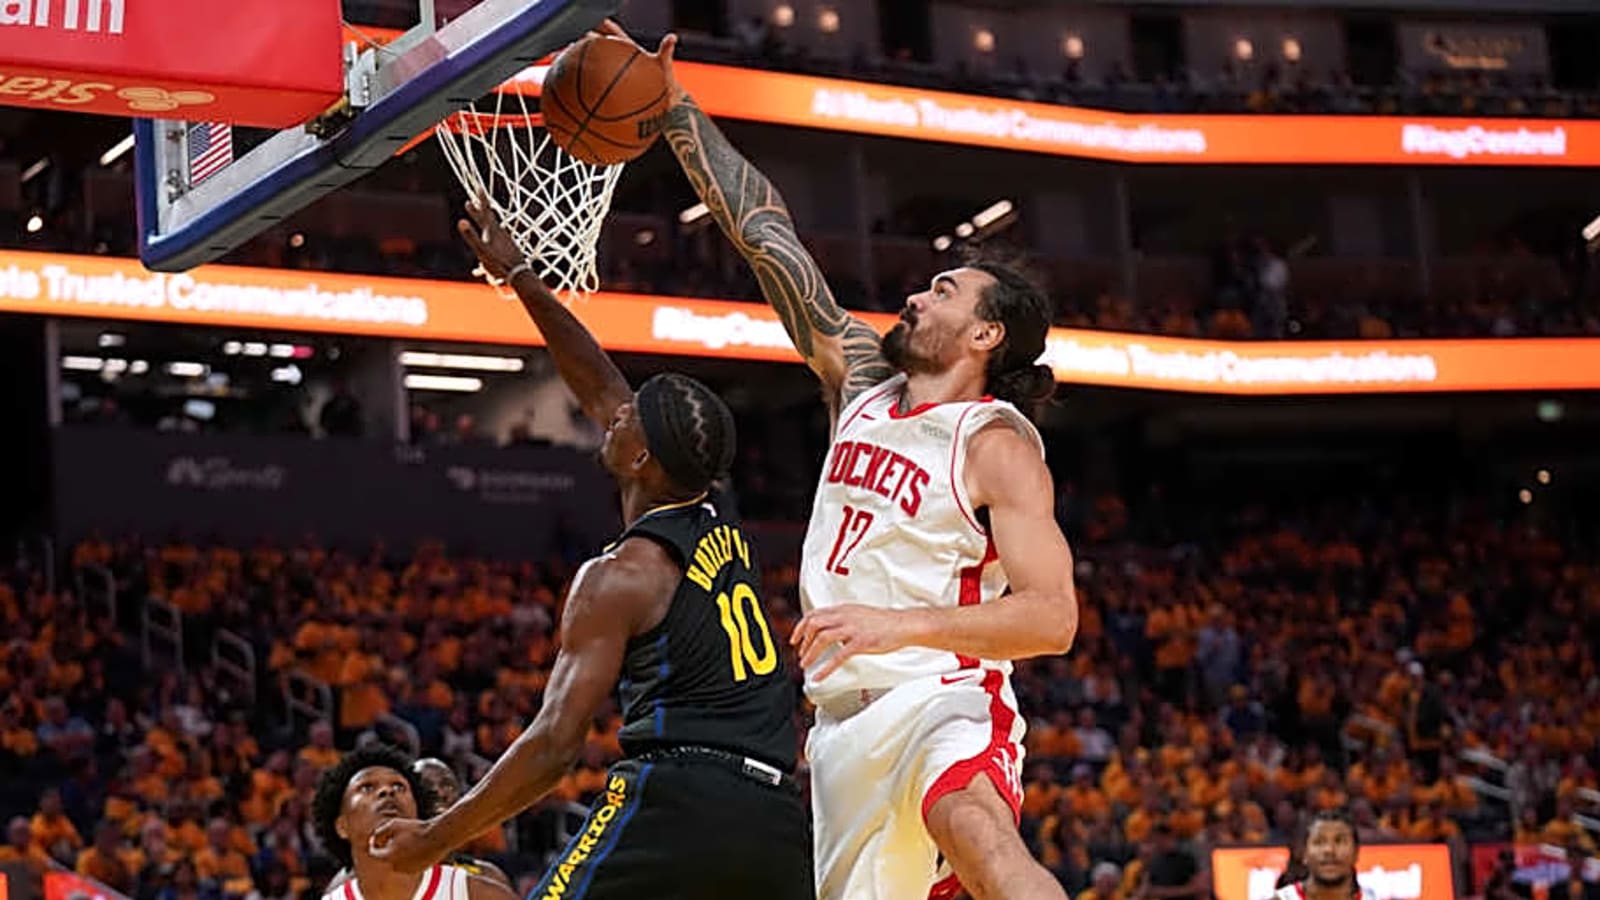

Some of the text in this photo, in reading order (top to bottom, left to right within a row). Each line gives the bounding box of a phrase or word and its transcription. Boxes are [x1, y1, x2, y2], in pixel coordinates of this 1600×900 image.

[0, 75, 115, 104] Sta
[918, 99, 1011, 138] Trusted
[1012, 109, 1206, 153] Communications
[1402, 125, 1566, 159] RingCentral
[41, 264, 163, 307] Trusted
[163, 272, 428, 326] Communications
[1219, 350, 1437, 384] Communications
[828, 441, 930, 518] OCKETS
[826, 505, 874, 576] 12
[716, 582, 777, 682] 10
[541, 776, 627, 900] WARRIORS
